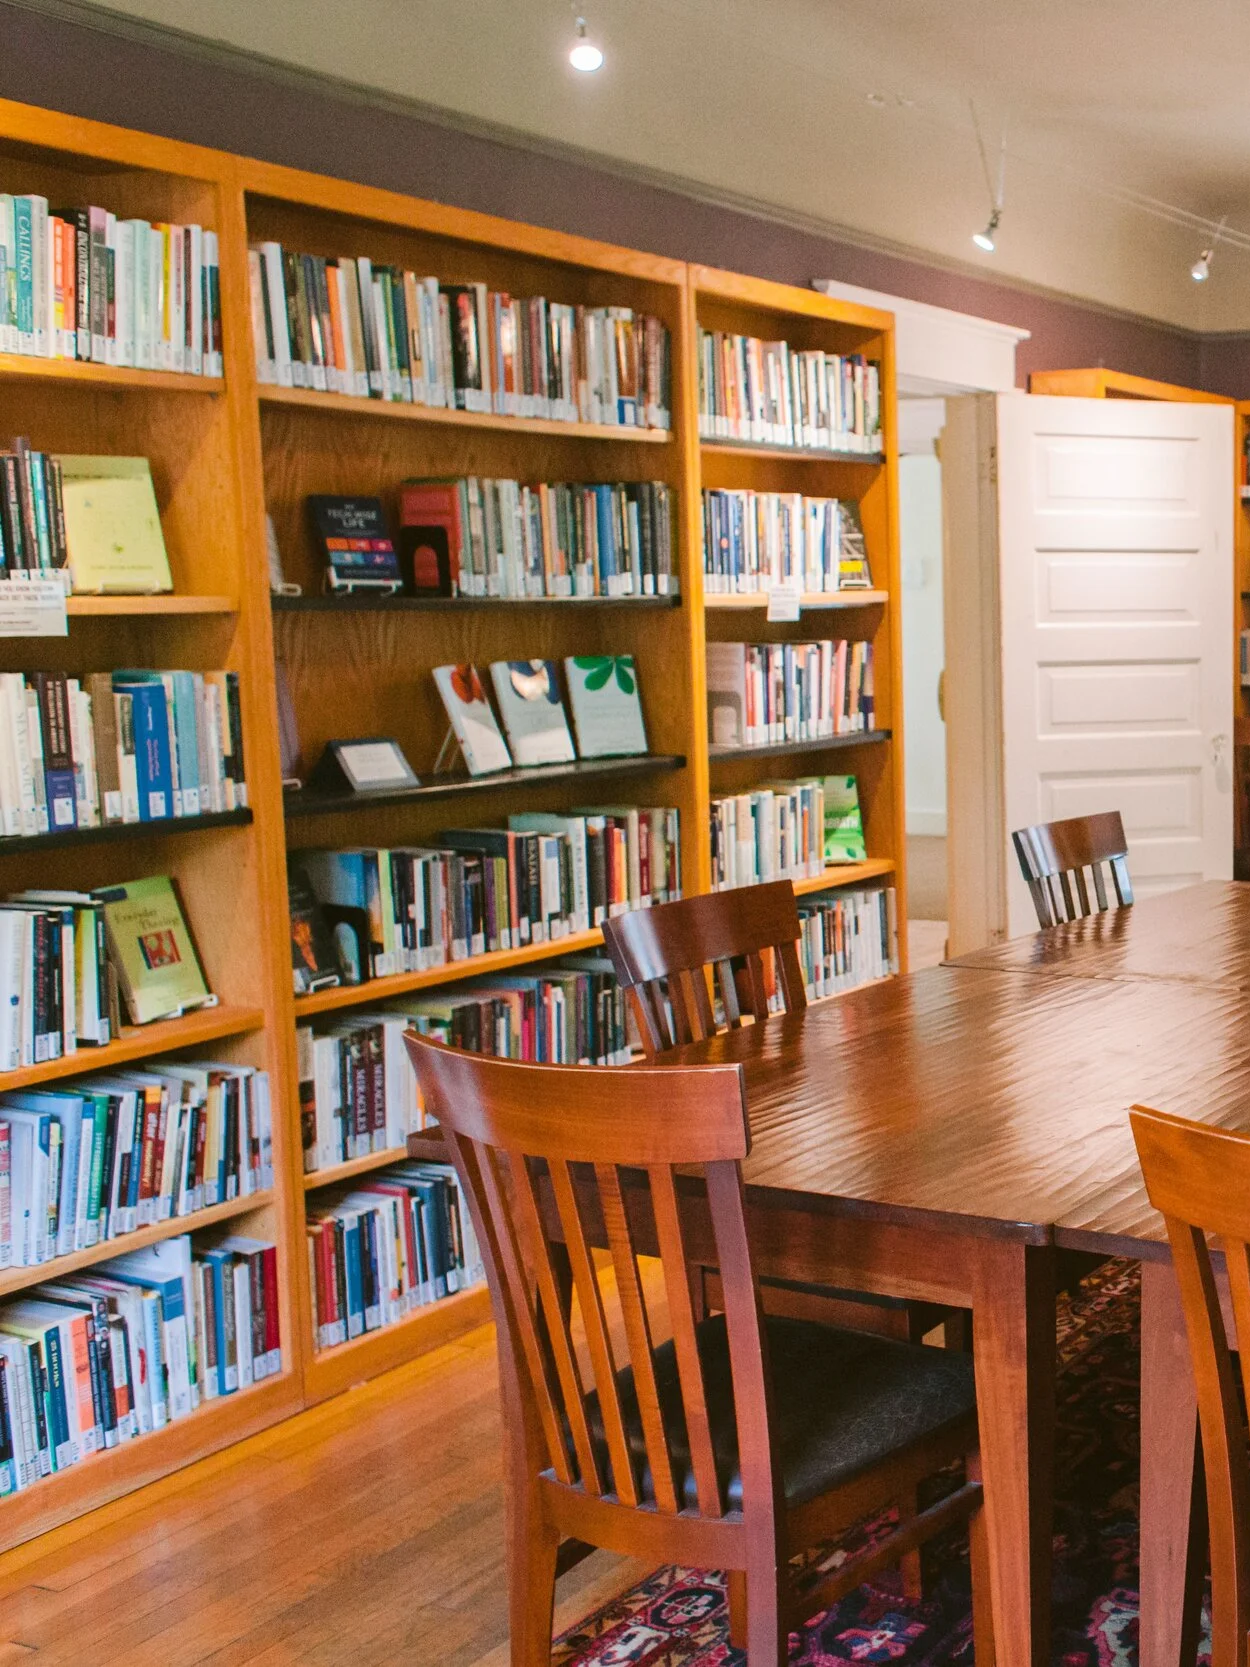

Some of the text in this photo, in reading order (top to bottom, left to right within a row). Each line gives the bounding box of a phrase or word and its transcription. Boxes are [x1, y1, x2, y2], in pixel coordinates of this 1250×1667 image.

[18, 215, 30, 281] CALLINGS
[343, 519, 366, 529] LIFE
[21, 763, 32, 799] SOUL
[528, 839, 538, 885] ISAIAH
[356, 1068, 367, 1132] MIRACLES
[374, 1063, 384, 1125] MIRACLES
[147, 1112, 157, 1139] after
